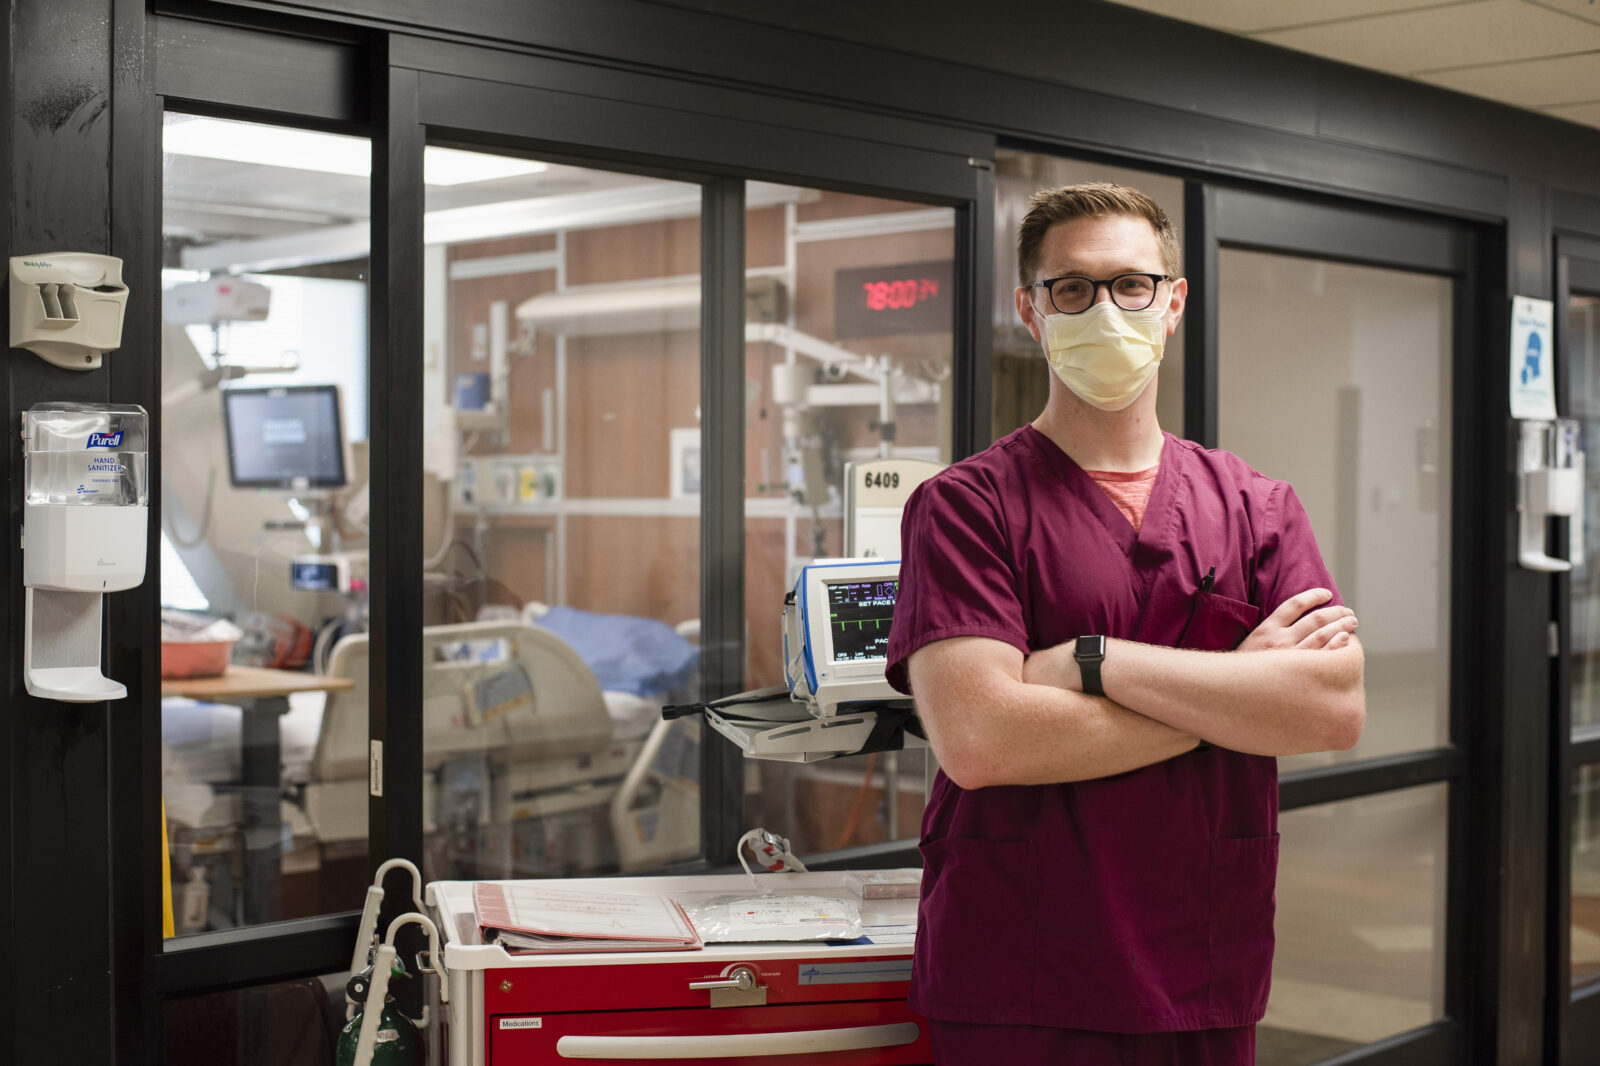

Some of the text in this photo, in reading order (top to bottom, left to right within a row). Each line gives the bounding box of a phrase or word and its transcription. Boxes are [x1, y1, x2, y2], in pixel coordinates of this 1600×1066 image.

[91, 433, 121, 446] Purell
[88, 464, 122, 472] SANITIZER
[865, 471, 900, 489] 6409
